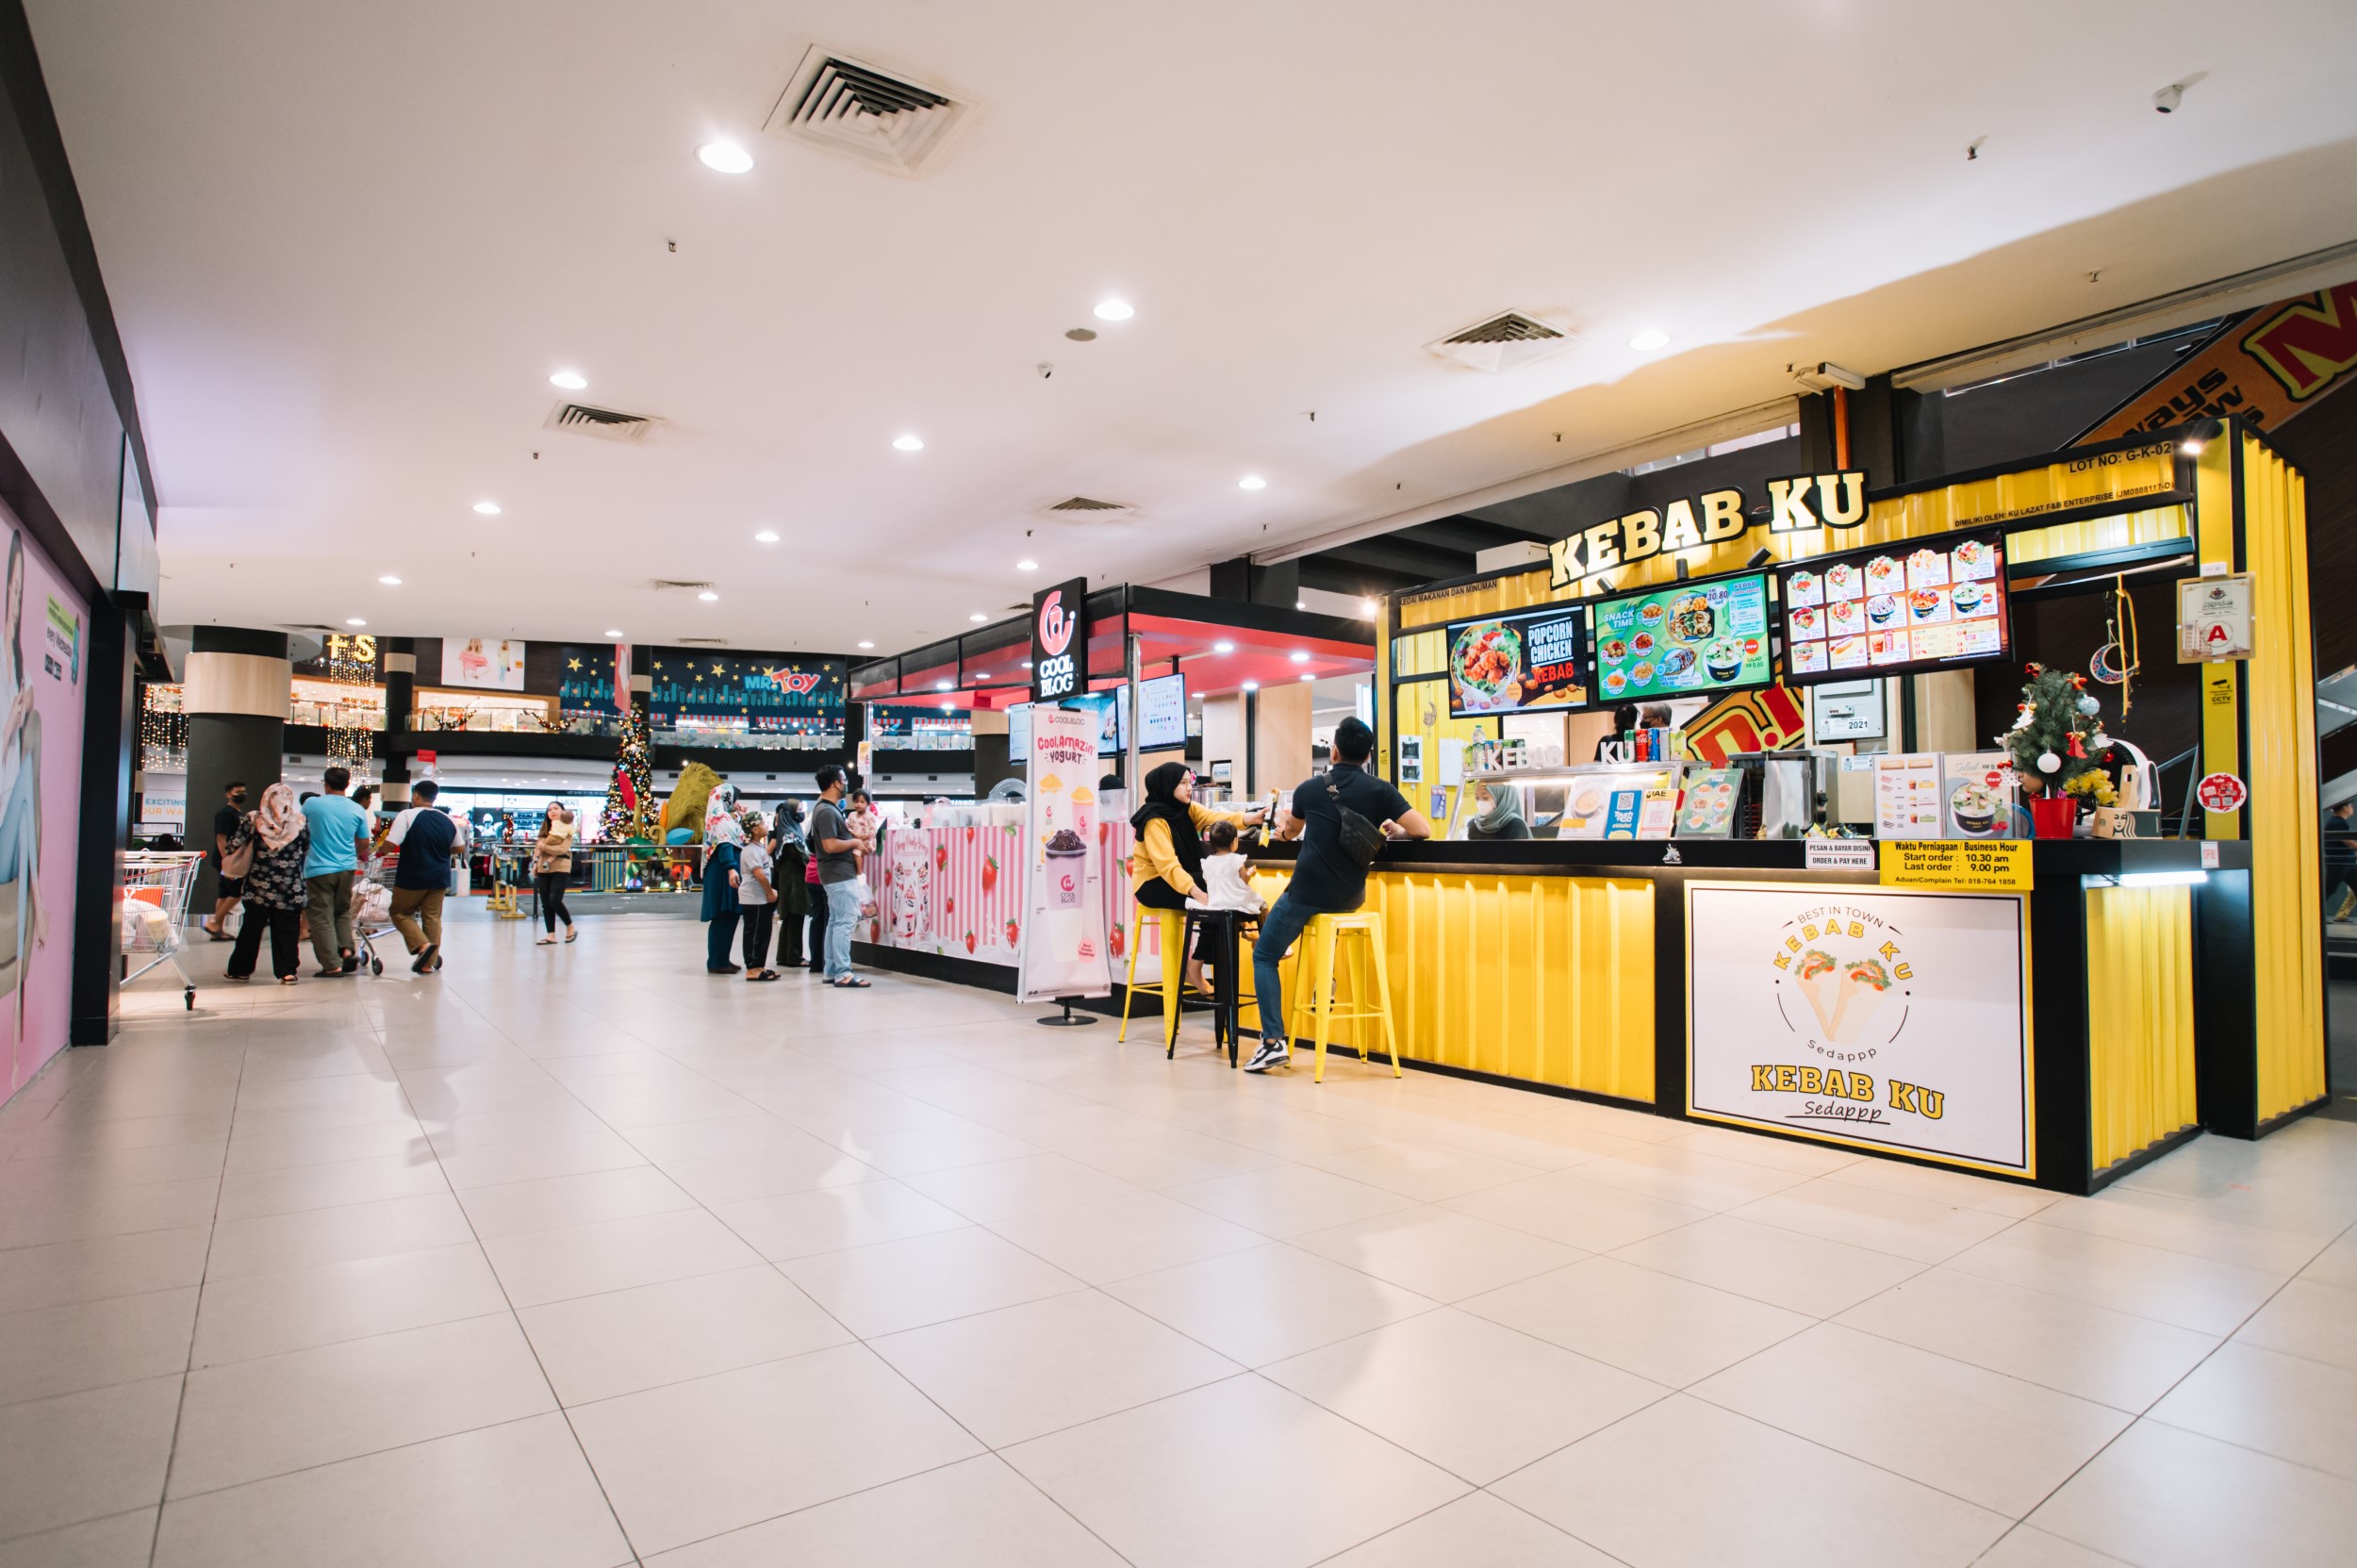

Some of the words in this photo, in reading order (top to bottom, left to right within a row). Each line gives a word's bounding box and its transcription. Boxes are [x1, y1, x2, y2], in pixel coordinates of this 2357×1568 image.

[2069, 458, 2094, 473] LOT
[2098, 454, 2122, 468] NO:
[2126, 443, 2171, 461] G-K-02
[1954, 516, 1984, 527] DIMILIKI
[1984, 512, 2006, 523] OLEH:
[2008, 508, 2019, 518] KU
[2020, 504, 2044, 516] LAZAT
[2046, 502, 2062, 510] F&B
[2064, 491, 2114, 507] ENTERPRISE
[1548, 489, 1744, 587] KEBAB
[1767, 471, 1865, 531] KU
[1399, 595, 1418, 605] KEDAI
[1418, 588, 1450, 602] MAKANAN
[1451, 586, 1465, 597] DAN
[1465, 580, 1498, 594] MINUMAN
[1707, 590, 1728, 600] 30.80
[1734, 581, 1757, 589] KEBAB
[1604, 610, 1635, 622] SNACK
[1612, 619, 1634, 629] TIME
[1527, 620, 1574, 647] POPCORN
[2207, 624, 2228, 642] A
[1530, 639, 1573, 664] CHICKEN
[1040, 654, 1074, 679] COOL
[1533, 662, 1574, 684] KEBAB
[1041, 674, 1074, 698] BLOG
[1848, 720, 1868, 730] 2021
[1488, 744, 1563, 770] KEBAB
[1600, 740, 1635, 764] KU
[1895, 841, 1917, 851] Waktu
[1918, 842, 1958, 852] Perniagaan
[1964, 842, 1997, 851] Business
[1999, 842, 2018, 852] Hour
[1904, 852, 1925, 862] Start
[1930, 853, 1953, 862] order
[1966, 853, 1991, 863] 10.30
[1904, 862, 1923, 871] Last
[1926, 863, 1953, 871] order
[1970, 863, 1991, 872] 9.00
[1993, 865, 2010, 873] pm
[1895, 876, 1952, 884] Aduan/Complain
[1797, 907, 1825, 924] BEST
[1829, 906, 1841, 915] IN
[1845, 907, 1884, 928] TOWN
[1773, 919, 1865, 970] KEBAB
[1879, 940, 1914, 981] KU
[1807, 1039, 1876, 1063] Sedappp
[1751, 1065, 1874, 1102] KEBAB
[1888, 1079, 1945, 1120] KU
[1805, 1100, 1882, 1124] Sedappp
